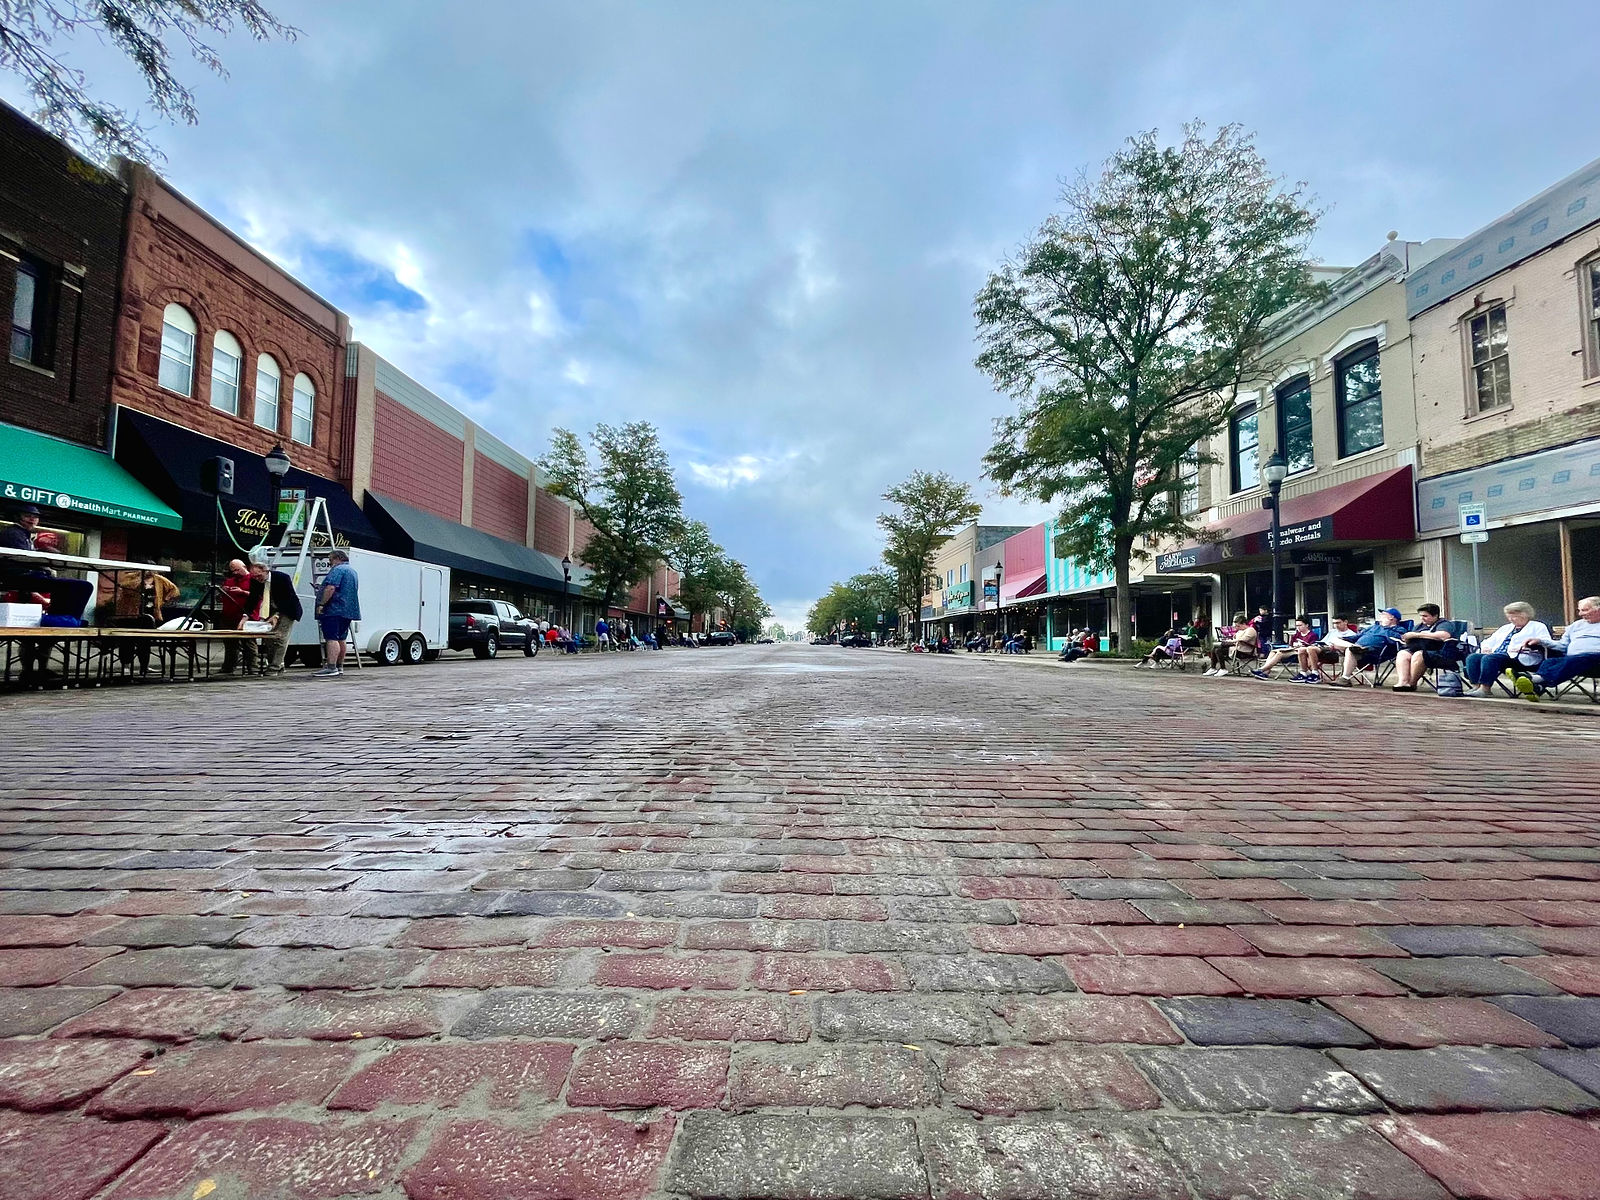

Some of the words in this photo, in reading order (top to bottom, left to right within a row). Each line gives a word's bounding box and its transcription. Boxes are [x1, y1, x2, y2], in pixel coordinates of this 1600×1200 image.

[4, 484, 17, 498] &
[21, 487, 56, 505] GIFT
[71, 499, 101, 512] Health
[101, 505, 121, 516] Mart
[122, 511, 159, 523] PHARMACY
[235, 508, 270, 531] Holis
[335, 532, 351, 548] Spa
[1267, 527, 1306, 540] Fomalwear
[1308, 520, 1322, 531] and
[1269, 537, 1293, 548] Txedo
[1294, 531, 1322, 543] Rentals
[1221, 543, 1234, 560] &
